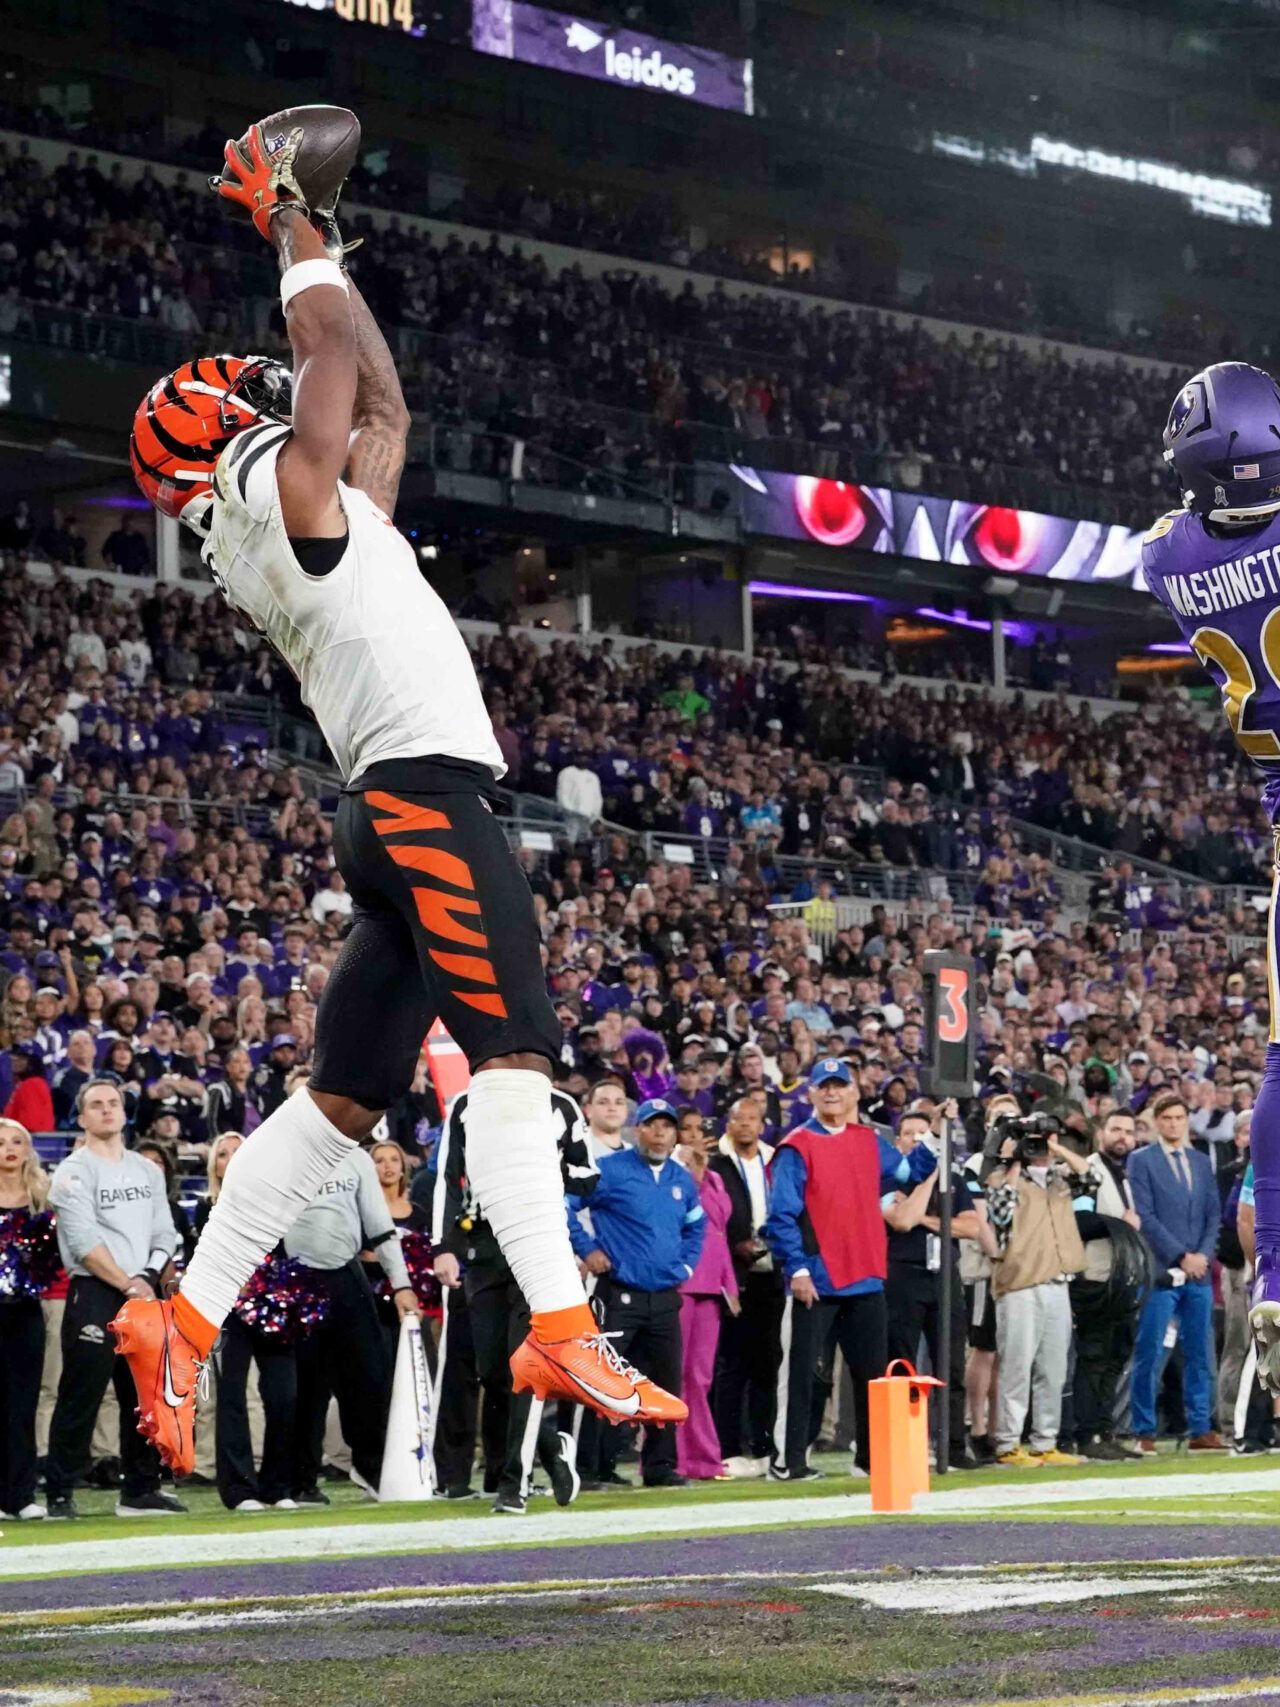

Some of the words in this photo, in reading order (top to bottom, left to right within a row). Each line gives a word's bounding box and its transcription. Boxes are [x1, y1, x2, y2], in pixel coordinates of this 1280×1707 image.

[605, 38, 696, 96] leidos
[1269, 485, 1280, 498] 29
[938, 968, 968, 1042] 3
